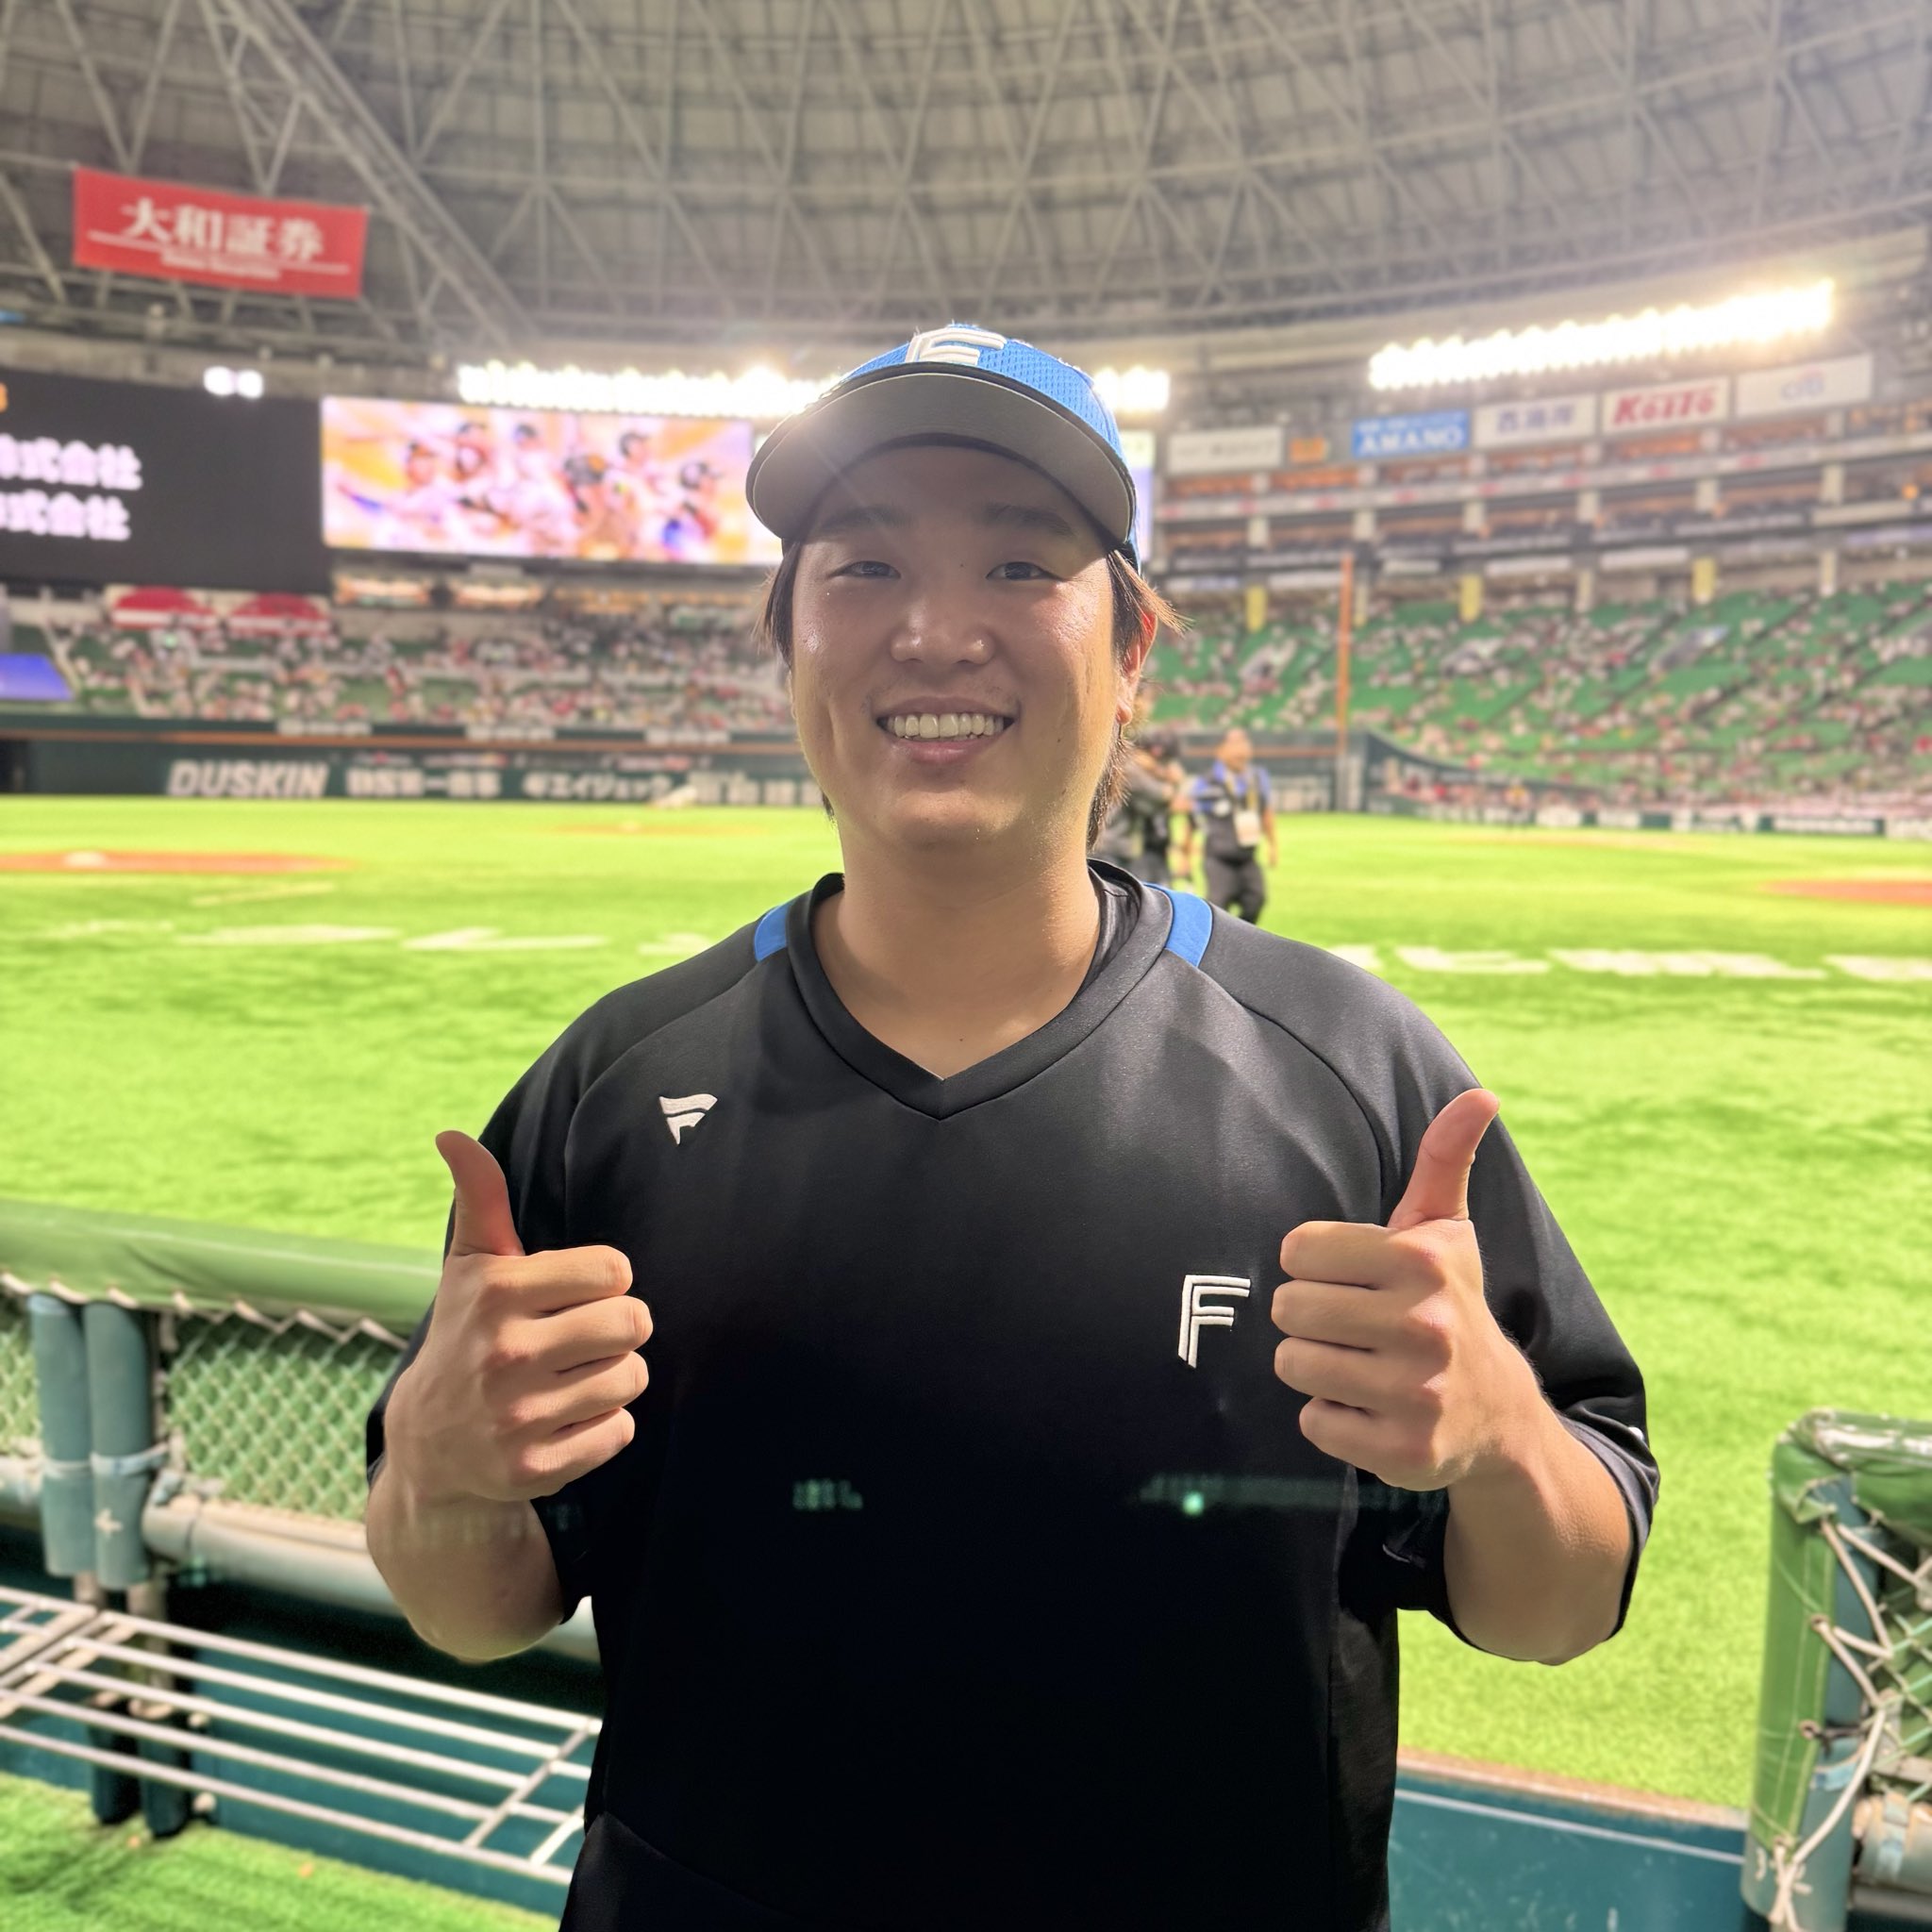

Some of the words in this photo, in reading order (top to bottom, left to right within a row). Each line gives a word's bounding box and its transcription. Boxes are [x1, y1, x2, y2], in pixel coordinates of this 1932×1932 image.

[121, 196, 324, 262] 大和証券
[1359, 425, 1464, 455] AMANO
[167, 758, 329, 796] DUSKIN
[1177, 1274, 1251, 1369] F
